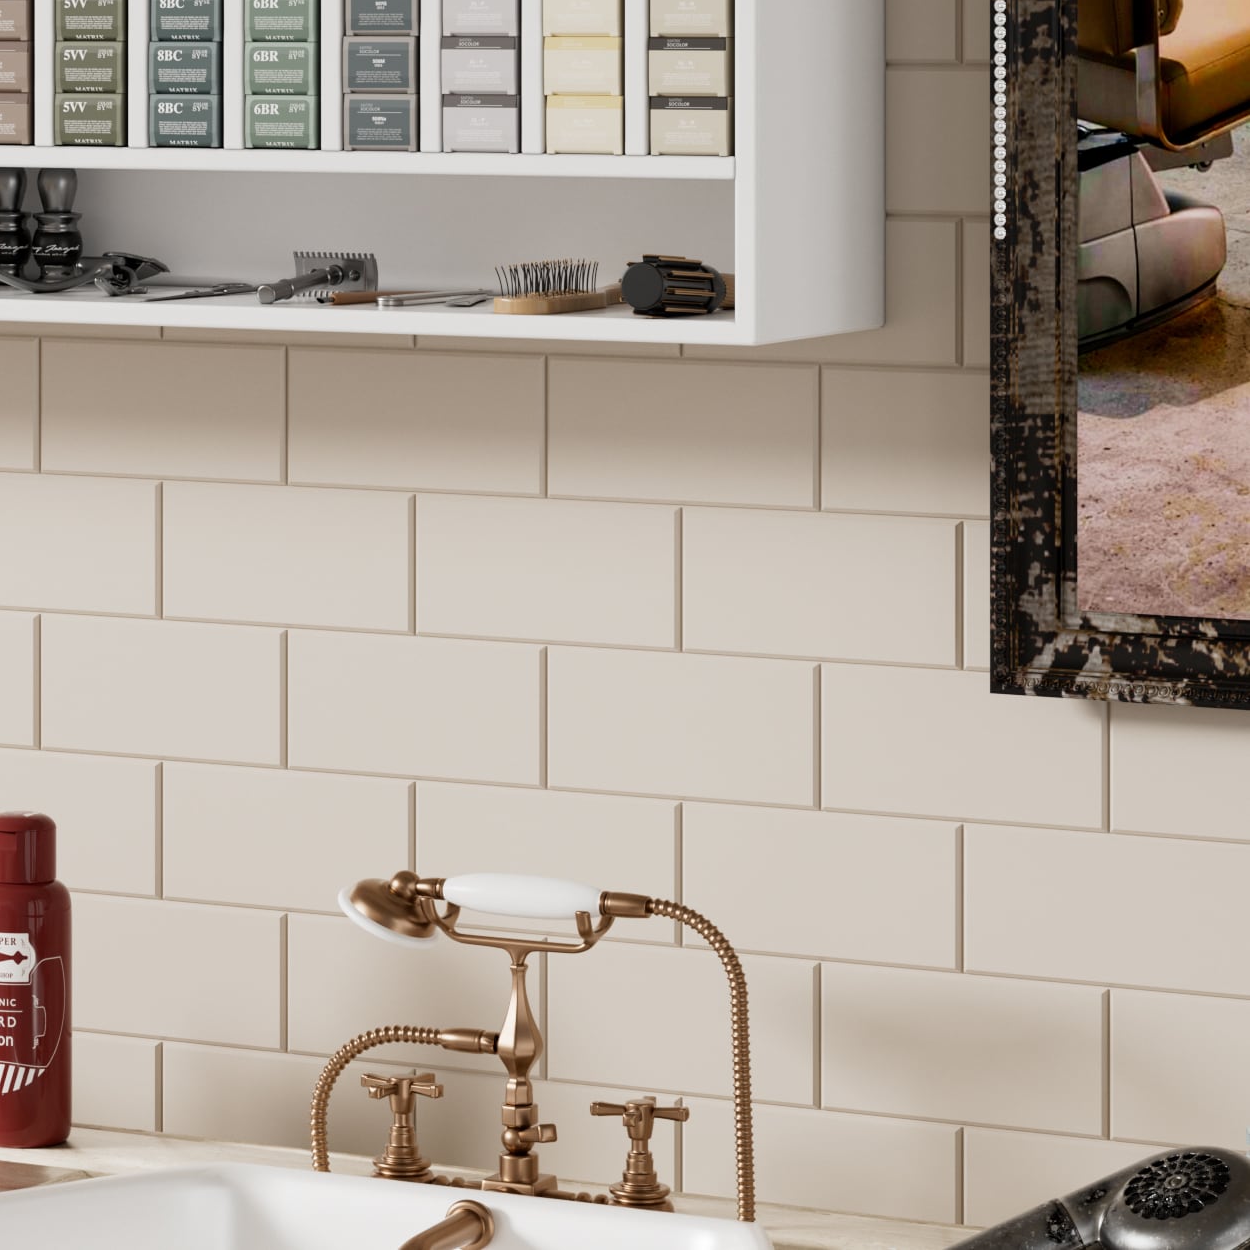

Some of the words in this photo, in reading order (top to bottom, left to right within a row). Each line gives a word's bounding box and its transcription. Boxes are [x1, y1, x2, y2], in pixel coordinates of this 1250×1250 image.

[63, 49, 88, 61] 5VV
[157, 49, 183, 62] 8BC
[253, 50, 279, 62] 6BR
[62, 101, 87, 113] 5VV
[158, 102, 184, 114] 8BC
[253, 103, 280, 115] 6BR
